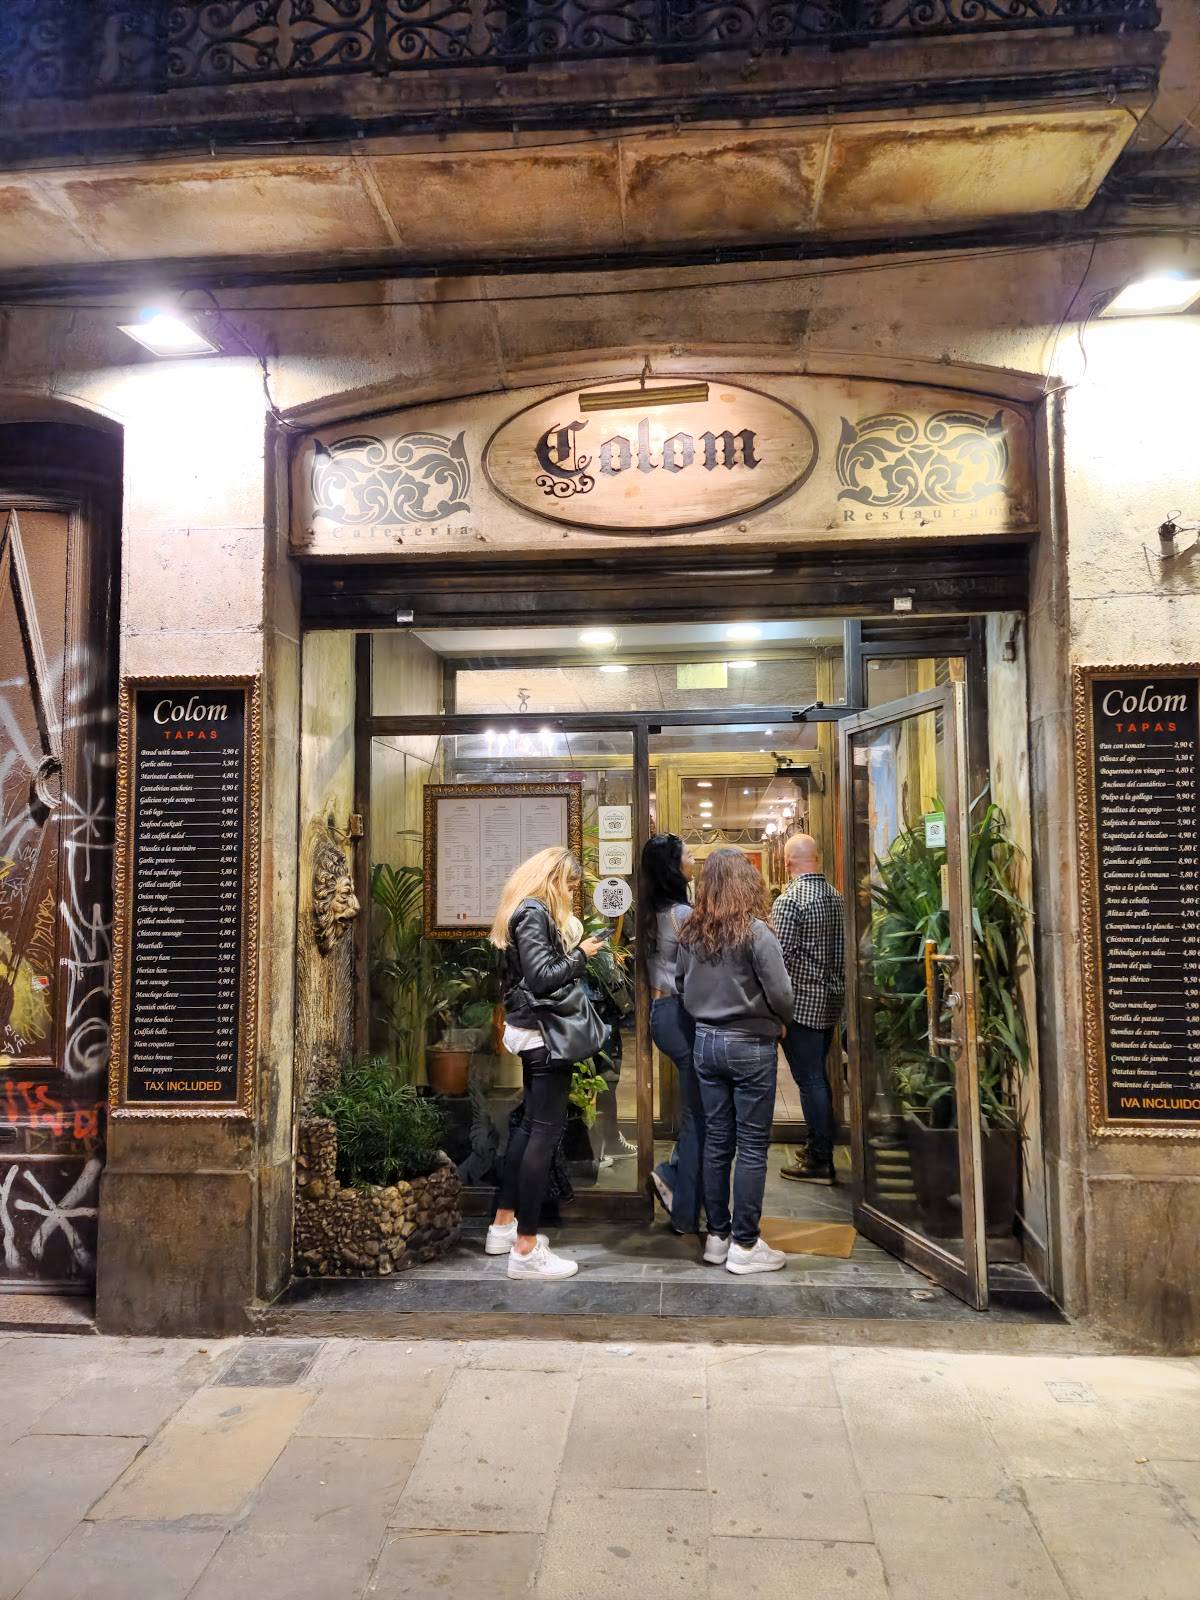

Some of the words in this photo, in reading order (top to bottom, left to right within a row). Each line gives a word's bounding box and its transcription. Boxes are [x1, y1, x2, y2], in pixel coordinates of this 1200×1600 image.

[534, 416, 762, 488] Colom
[332, 525, 469, 538] Cafeteria
[1102, 685, 1188, 716] Colom
[154, 696, 228, 724] Colom
[1115, 722, 1177, 732] TAPAS
[164, 730, 218, 740] TAPAS
[140, 760, 156, 769] Garlic
[161, 820, 184, 828] cocktail
[144, 1082, 164, 1091] TAX
[167, 1081, 221, 1091] INCLUDED
[1120, 1098, 1140, 1108] IVA
[1143, 1098, 1200, 1109] INCLUIDO
